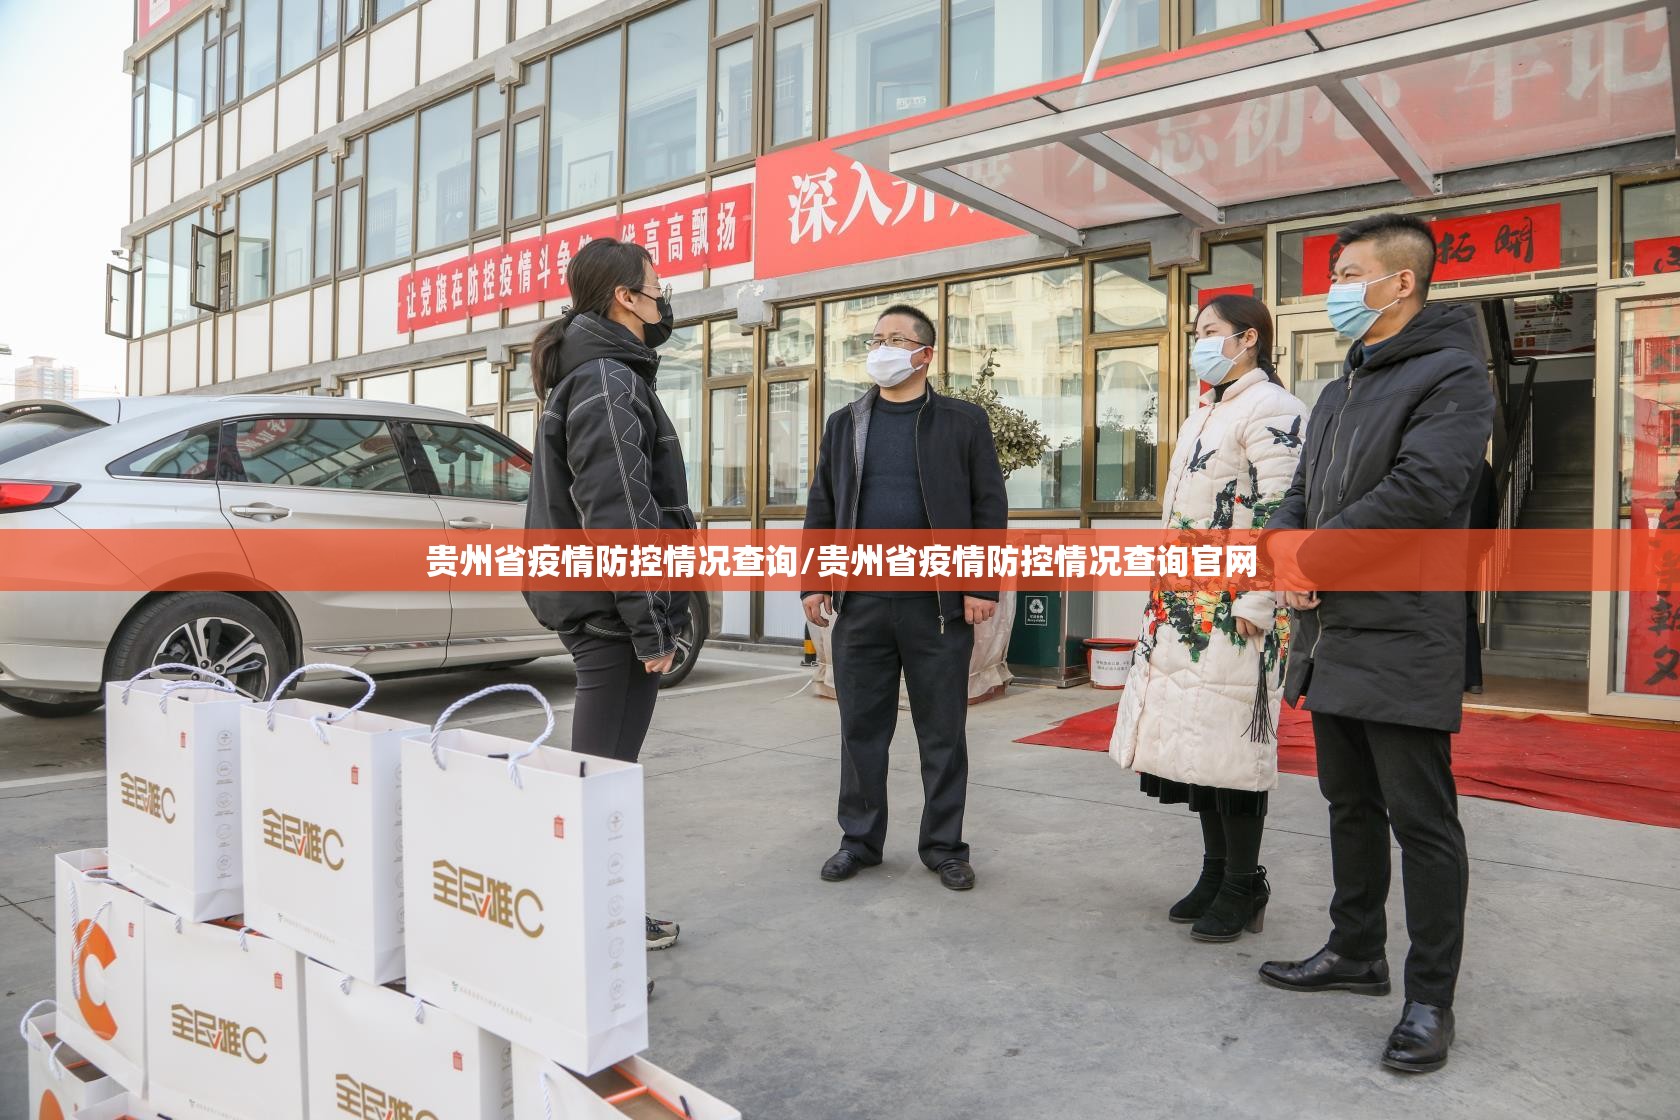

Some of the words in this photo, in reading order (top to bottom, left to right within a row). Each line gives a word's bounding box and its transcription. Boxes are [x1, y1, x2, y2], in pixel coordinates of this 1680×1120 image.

[405, 201, 737, 319] 让党旗在防控疫情斗争高高飘扬
